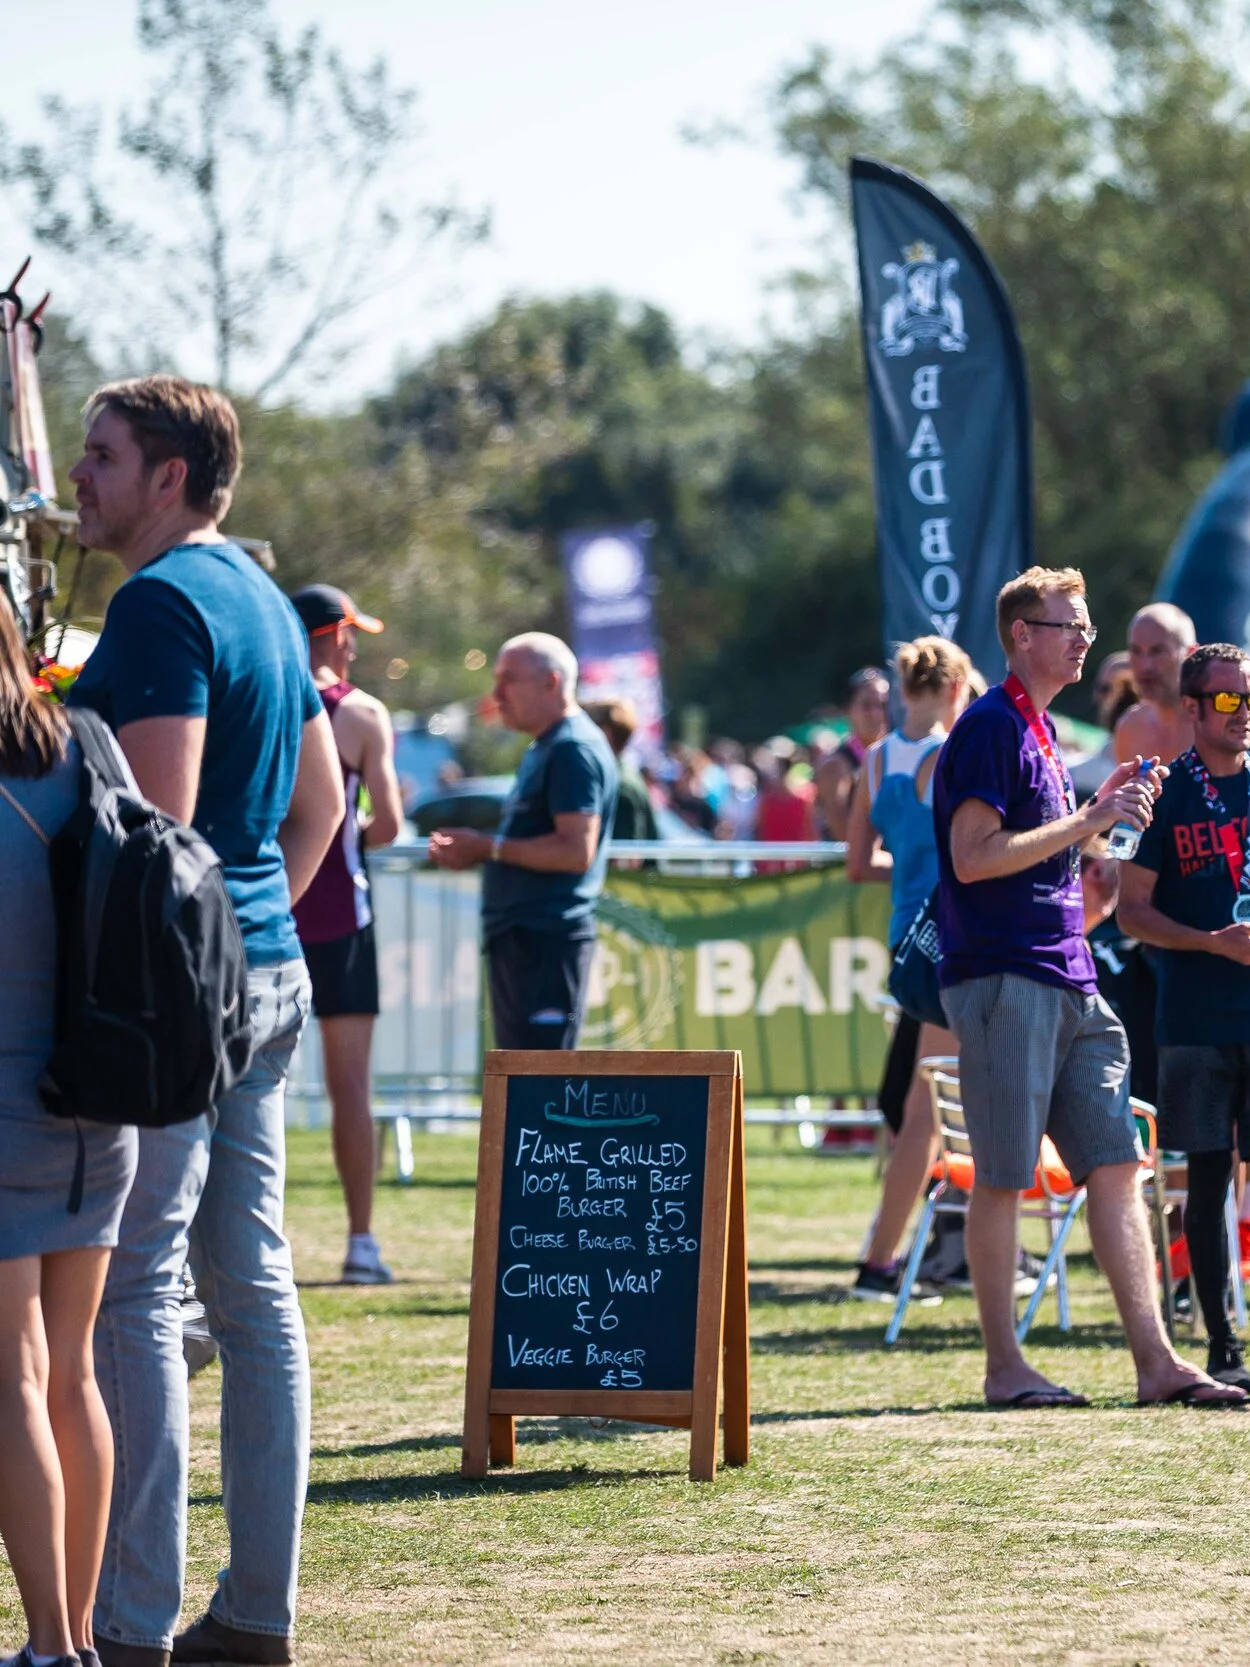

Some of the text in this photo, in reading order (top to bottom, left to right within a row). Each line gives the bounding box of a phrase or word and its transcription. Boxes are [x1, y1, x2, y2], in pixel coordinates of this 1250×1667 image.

[564, 1078, 646, 1117] MENU
[515, 1128, 687, 1168] FLAME GRILLED
[522, 1170, 570, 1196] 100%
[649, 1169, 692, 1193] BEEF
[556, 1196, 686, 1233] BURGER £5
[510, 1225, 568, 1249] CHEESE
[578, 1229, 636, 1251] BURGER
[501, 1263, 662, 1298] CHICKEN WRAP
[508, 1334, 647, 1367] VEGGIE BURGER
[599, 1369, 643, 1388] £5
